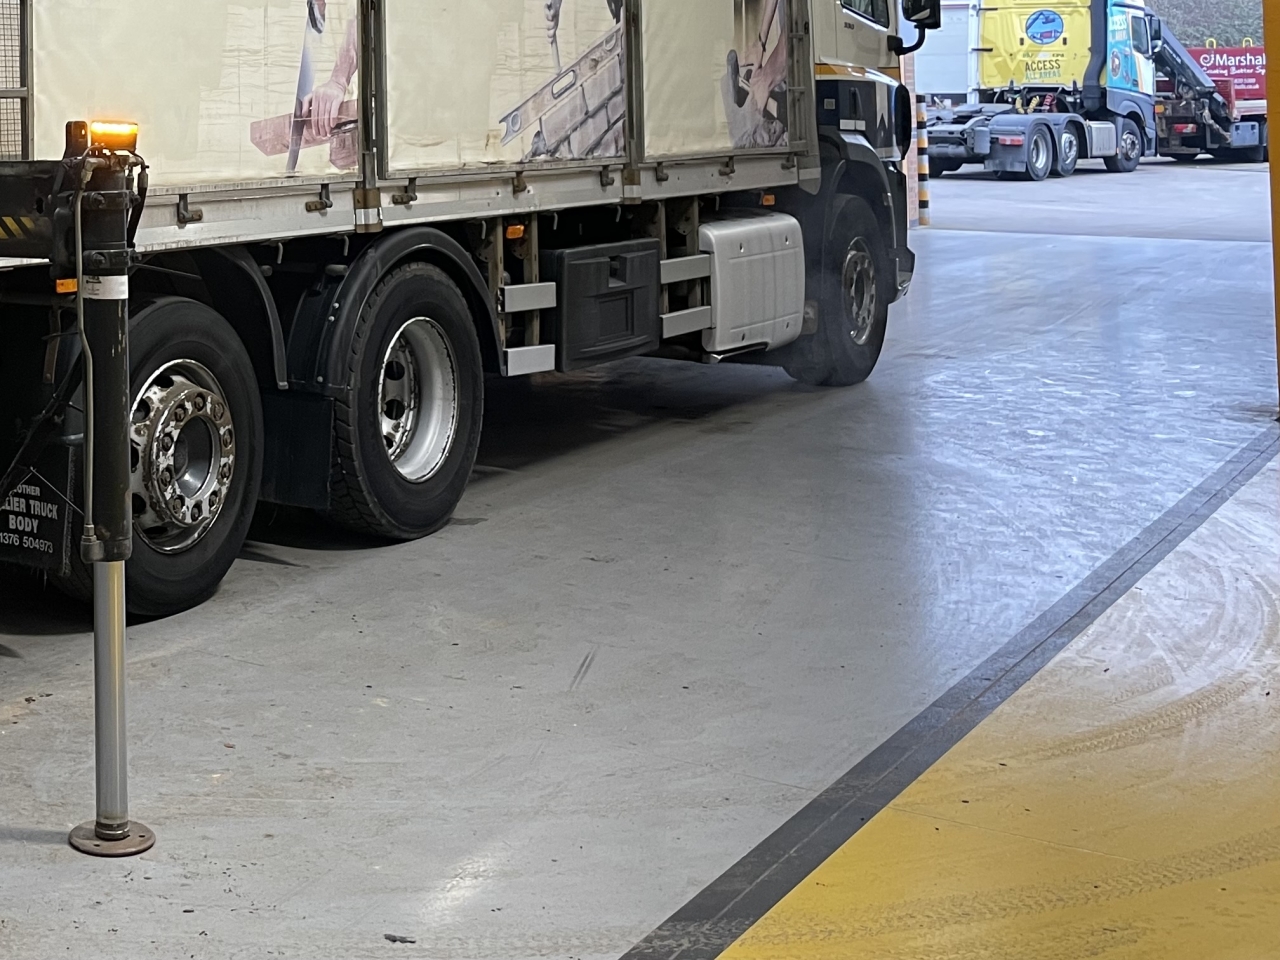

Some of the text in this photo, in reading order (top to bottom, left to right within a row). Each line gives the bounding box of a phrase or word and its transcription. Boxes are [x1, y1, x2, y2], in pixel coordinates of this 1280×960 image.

[1025, 59, 1061, 72] ACCESS
[29, 499, 58, 520] TRUCK
[8, 514, 39, 533] BODY
[23, 536, 53, 553] 504973
